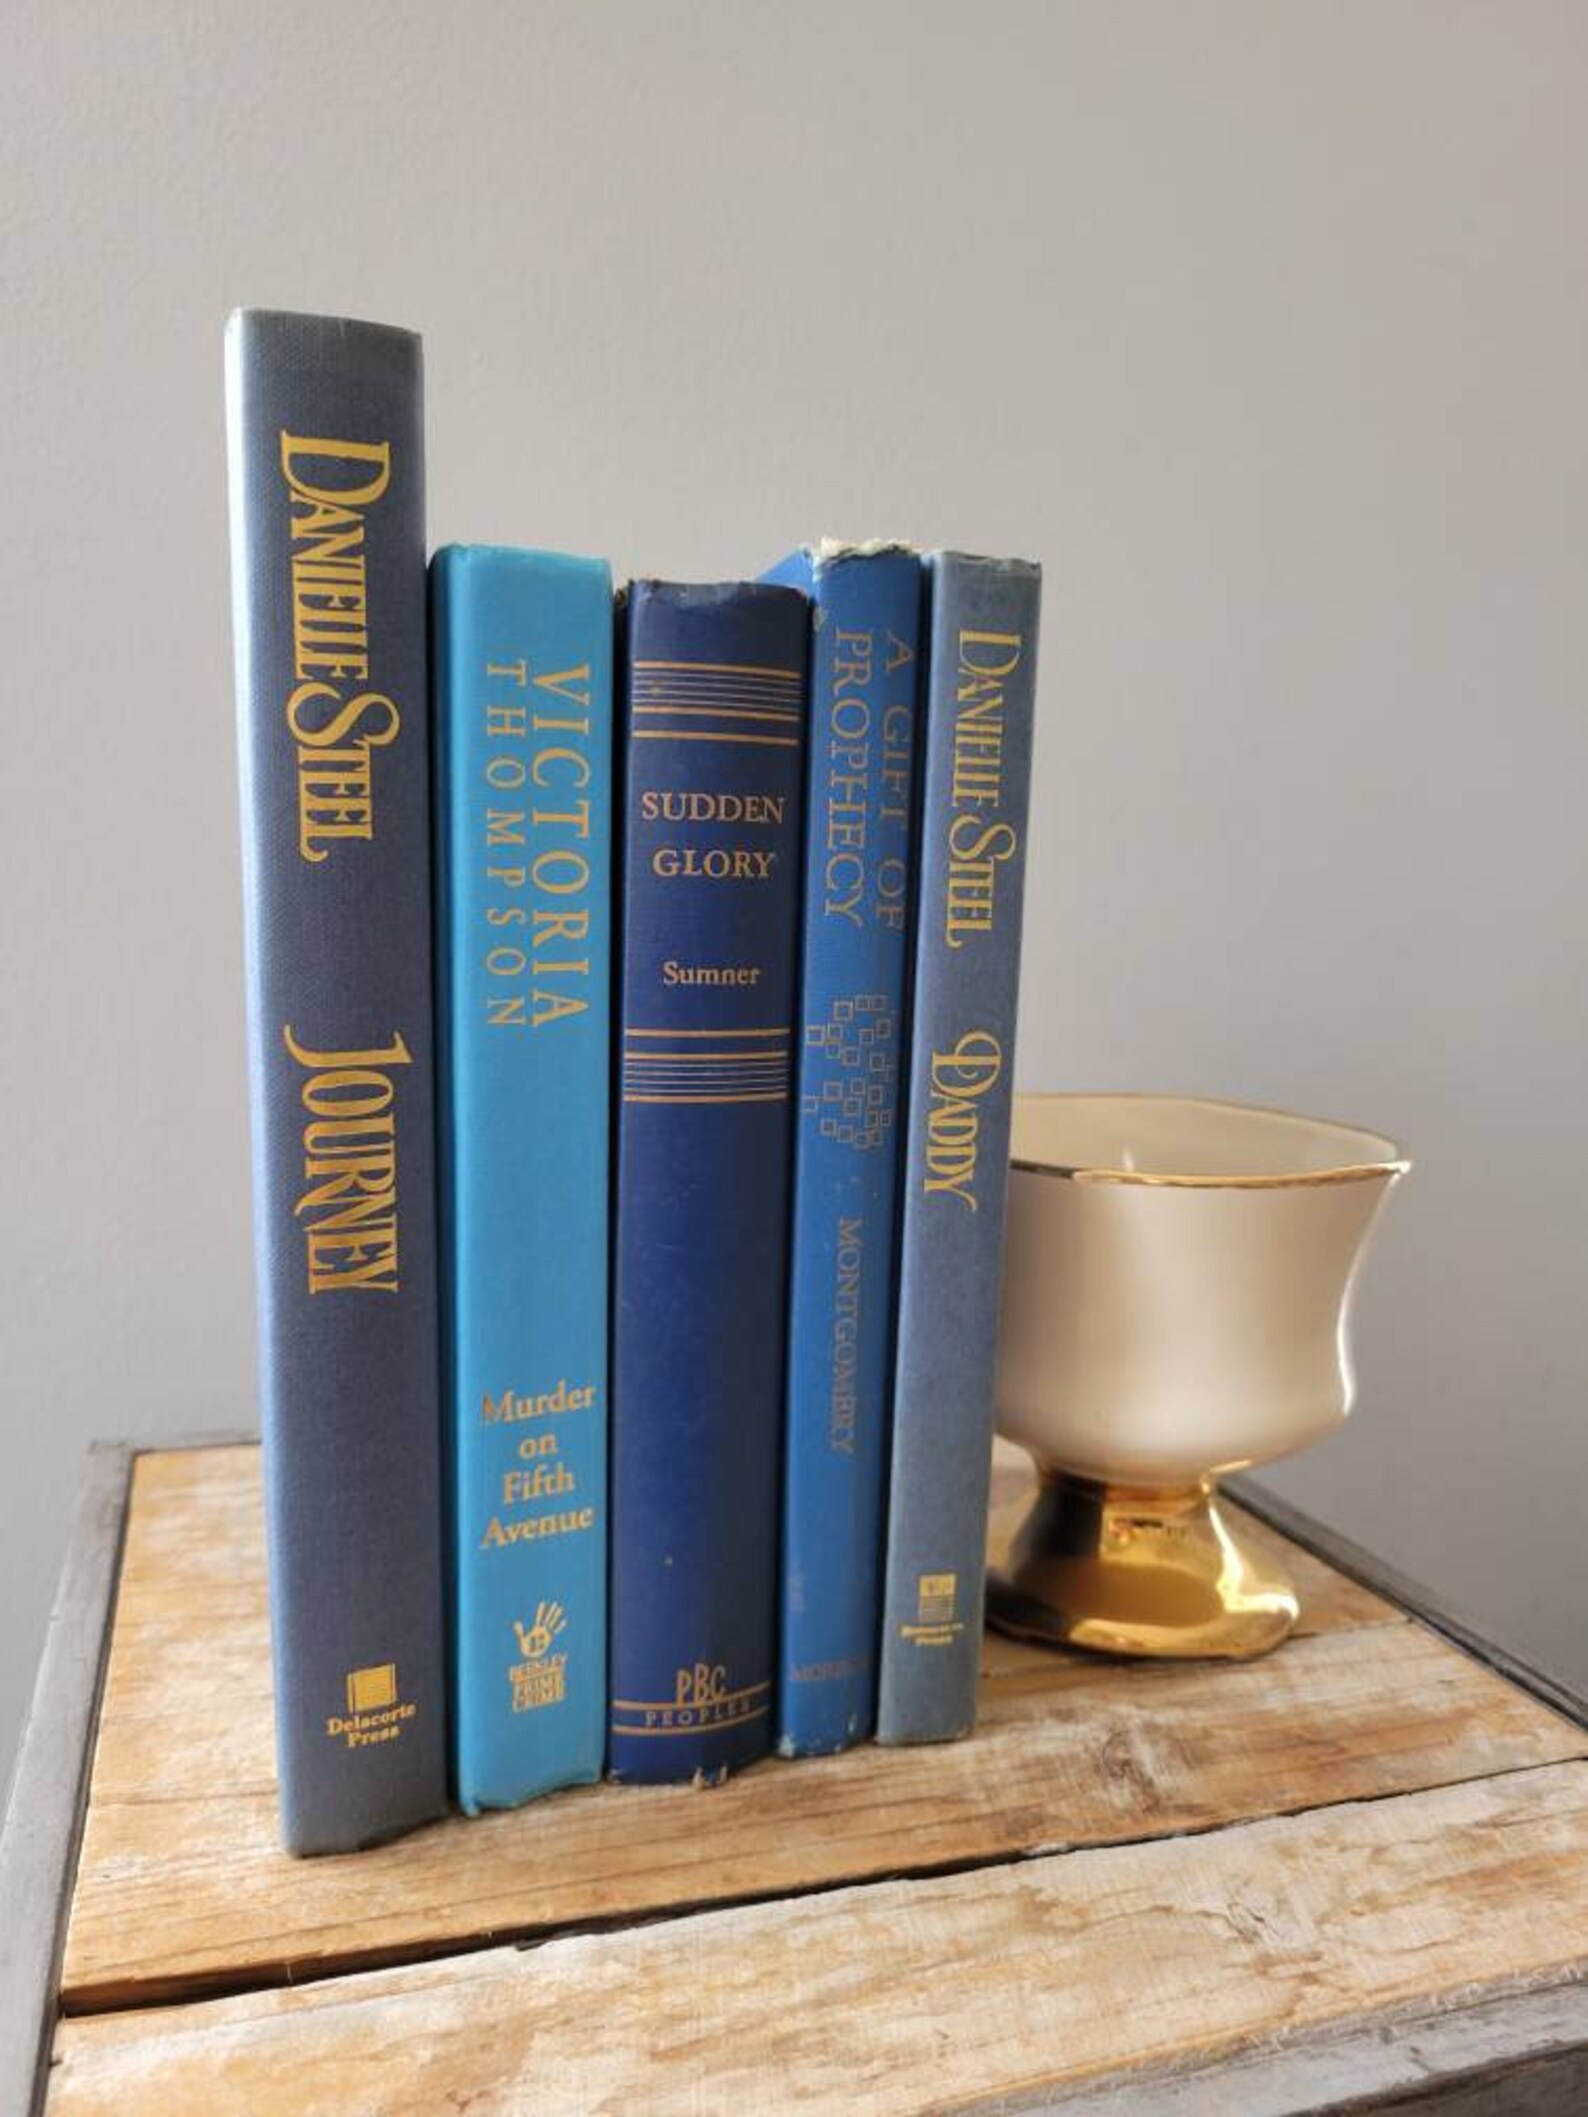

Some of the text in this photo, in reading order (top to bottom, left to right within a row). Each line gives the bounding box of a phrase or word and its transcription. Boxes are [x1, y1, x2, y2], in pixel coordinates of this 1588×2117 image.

[286, 681, 400, 863] STEEL
[824, 626, 873, 928] PROPHECY
[876, 628, 914, 932] A GIFT OF
[641, 791, 785, 824] SUDDEN
[487, 660, 526, 1025] THOMPSON
[532, 664, 591, 1026] VICTORIA
[652, 849, 776, 879] GLORY
[947, 814, 1016, 948] STEEL
[662, 960, 761, 986] Sumner
[923, 1029, 1003, 1213] DADDY
[283, 1024, 413, 1294] JOURNEY
[481, 1379, 597, 1427] Murder
[519, 1433, 558, 1460] on
[503, 1462, 574, 1505] Fifth
[480, 1507, 594, 1549] Avenue
[676, 1662, 727, 1707] PBC
[327, 1702, 417, 1736] Delacorte
[347, 1725, 401, 1748] Press
